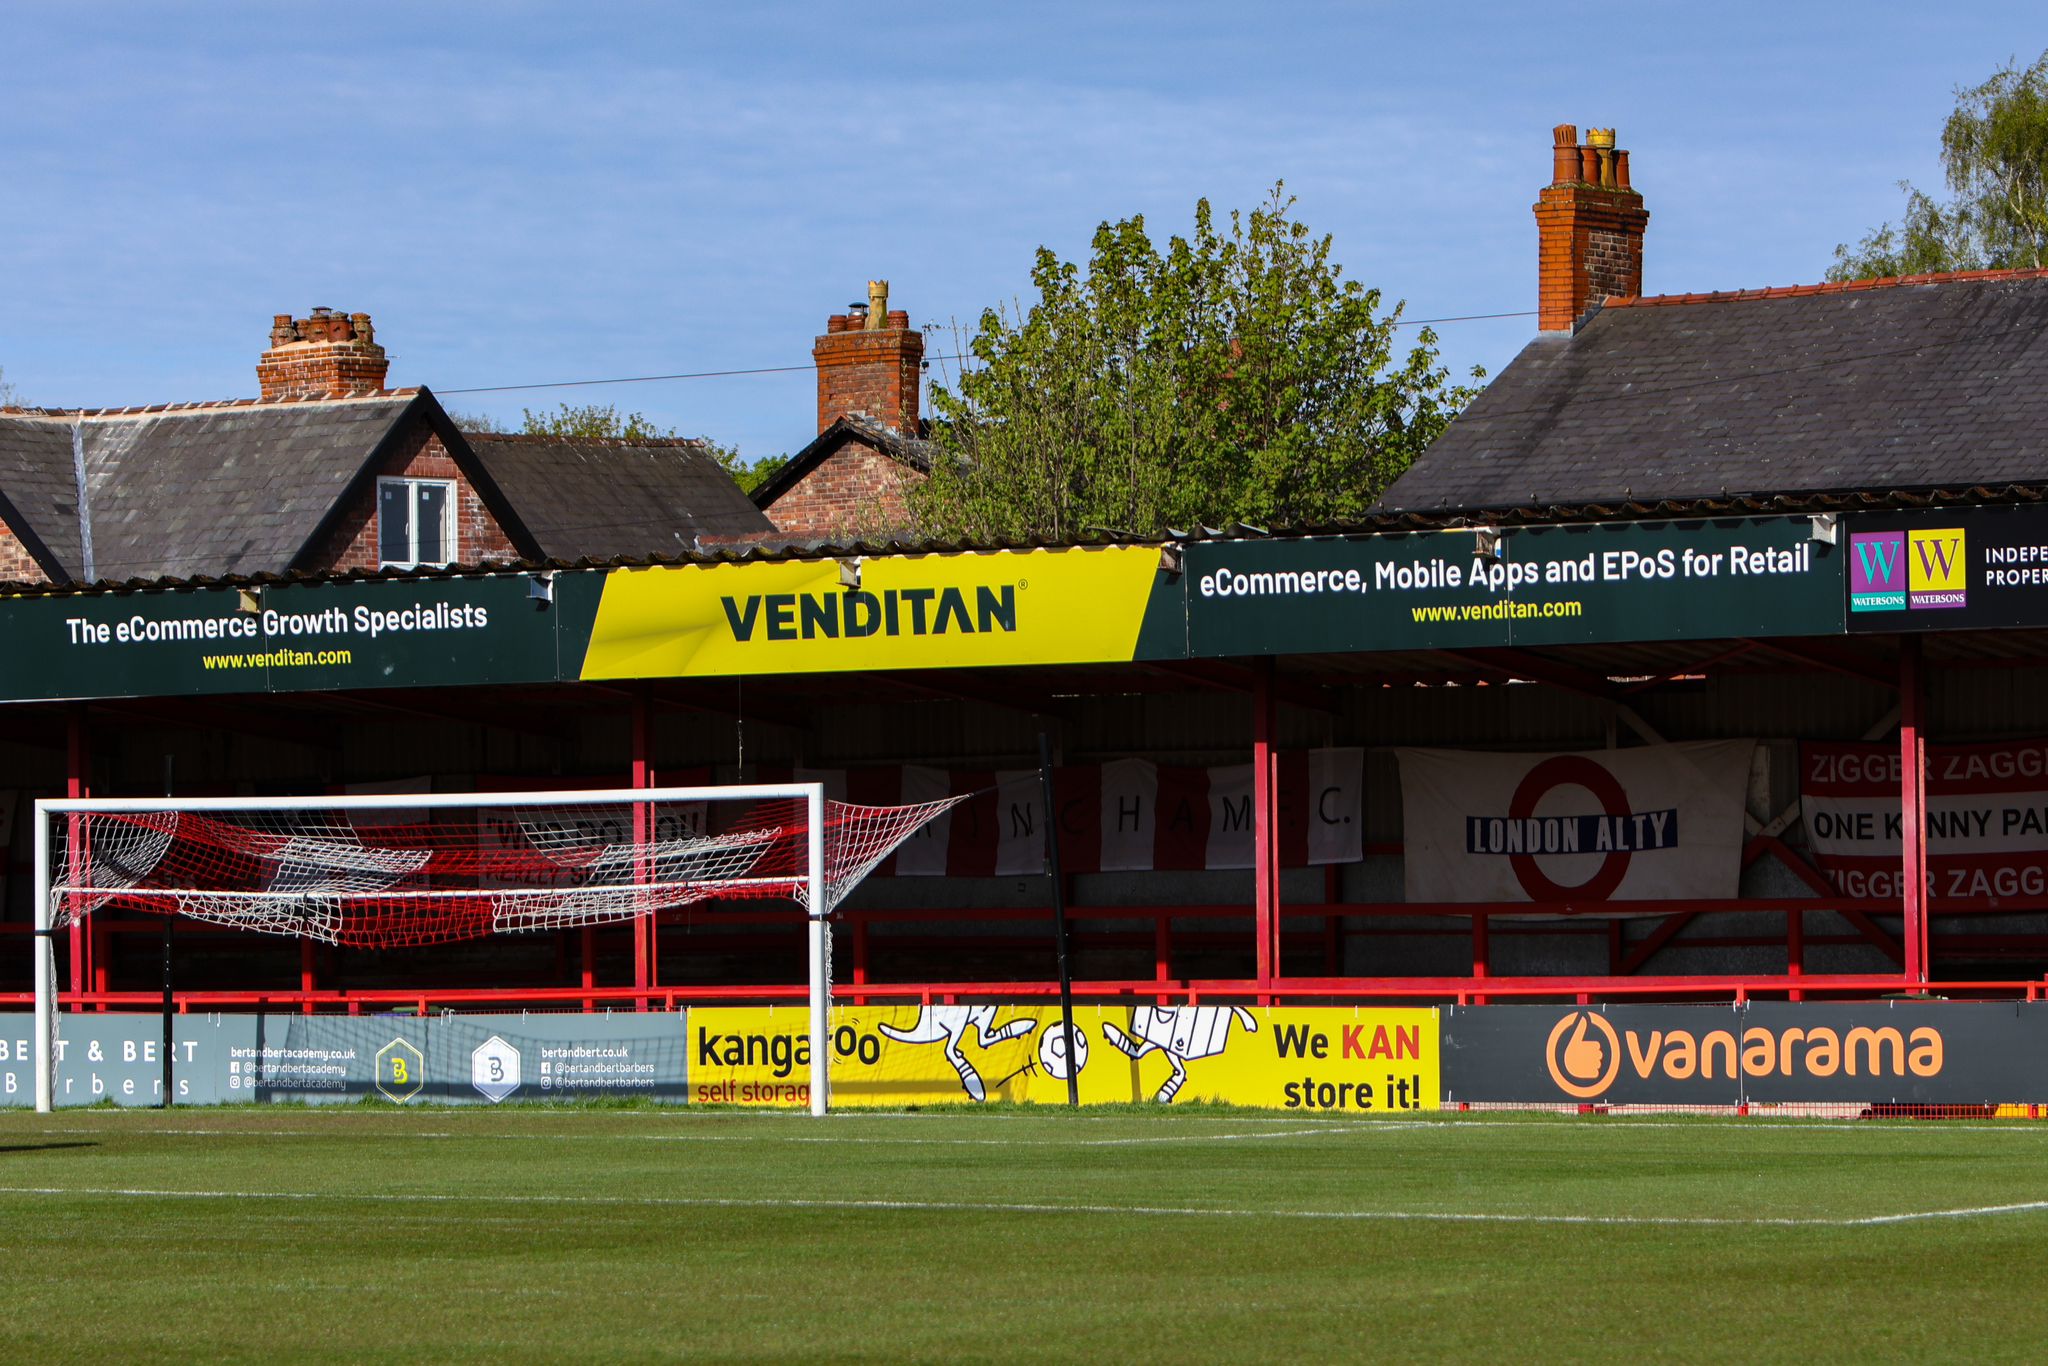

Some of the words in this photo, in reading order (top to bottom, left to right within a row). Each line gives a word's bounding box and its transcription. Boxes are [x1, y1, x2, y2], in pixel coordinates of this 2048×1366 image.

[1201, 568, 1367, 594] eCommerce,
[1375, 559, 1461, 590] Mobile
[1468, 556, 1539, 591] Apps
[1545, 560, 1595, 583] and
[1602, 551, 1676, 581] EPoS
[1681, 548, 1723, 577] for
[1730, 542, 1809, 575] Retail
[1854, 541, 1901, 584] W
[1913, 538, 1960, 582] W
[1412, 599, 1582, 622] www.venditan.com
[1853, 595, 1904, 606] WATERSONS
[1911, 593, 1965, 604] WATERSONS
[67, 618, 110, 644] The
[116, 614, 257, 643] eCommerce
[263, 606, 349, 636] Growth
[353, 602, 488, 637] Specialists
[203, 650, 351, 669] www.venditan.com
[1943, 747, 2048, 781] ZAGG
[1474, 818, 1578, 854] LONDON
[1595, 810, 1668, 852] ALTY
[1814, 812, 1874, 841] ONE
[1885, 809, 1992, 840] KNNY
[2002, 807, 2048, 836] PA
[1947, 865, 2048, 897] ZAGG
[0, 1039, 69, 1061] BET
[88, 1040, 104, 1062] &
[231, 1046, 355, 1060] bertandbertacademy.co.uk
[541, 1046, 628, 1058] bertandbert.co.uk
[699, 1025, 880, 1078] kangaoo
[1273, 1024, 1329, 1059] We
[1342, 1024, 1420, 1060] KAN
[1624, 1026, 1943, 1079] vanarama
[243, 1062, 346, 1075] @bertandbertacademy
[554, 1062, 655, 1074] @bertandbertbarbers
[554, 1076, 655, 1088] @bertandbertbarbers
[5, 1072, 189, 1095] Brbers
[243, 1076, 346, 1090] @bertandbertacademy
[697, 1079, 737, 1102] self
[742, 1080, 811, 1108] storag
[1284, 1077, 1373, 1109] store
[1387, 1074, 1420, 1109] it!
